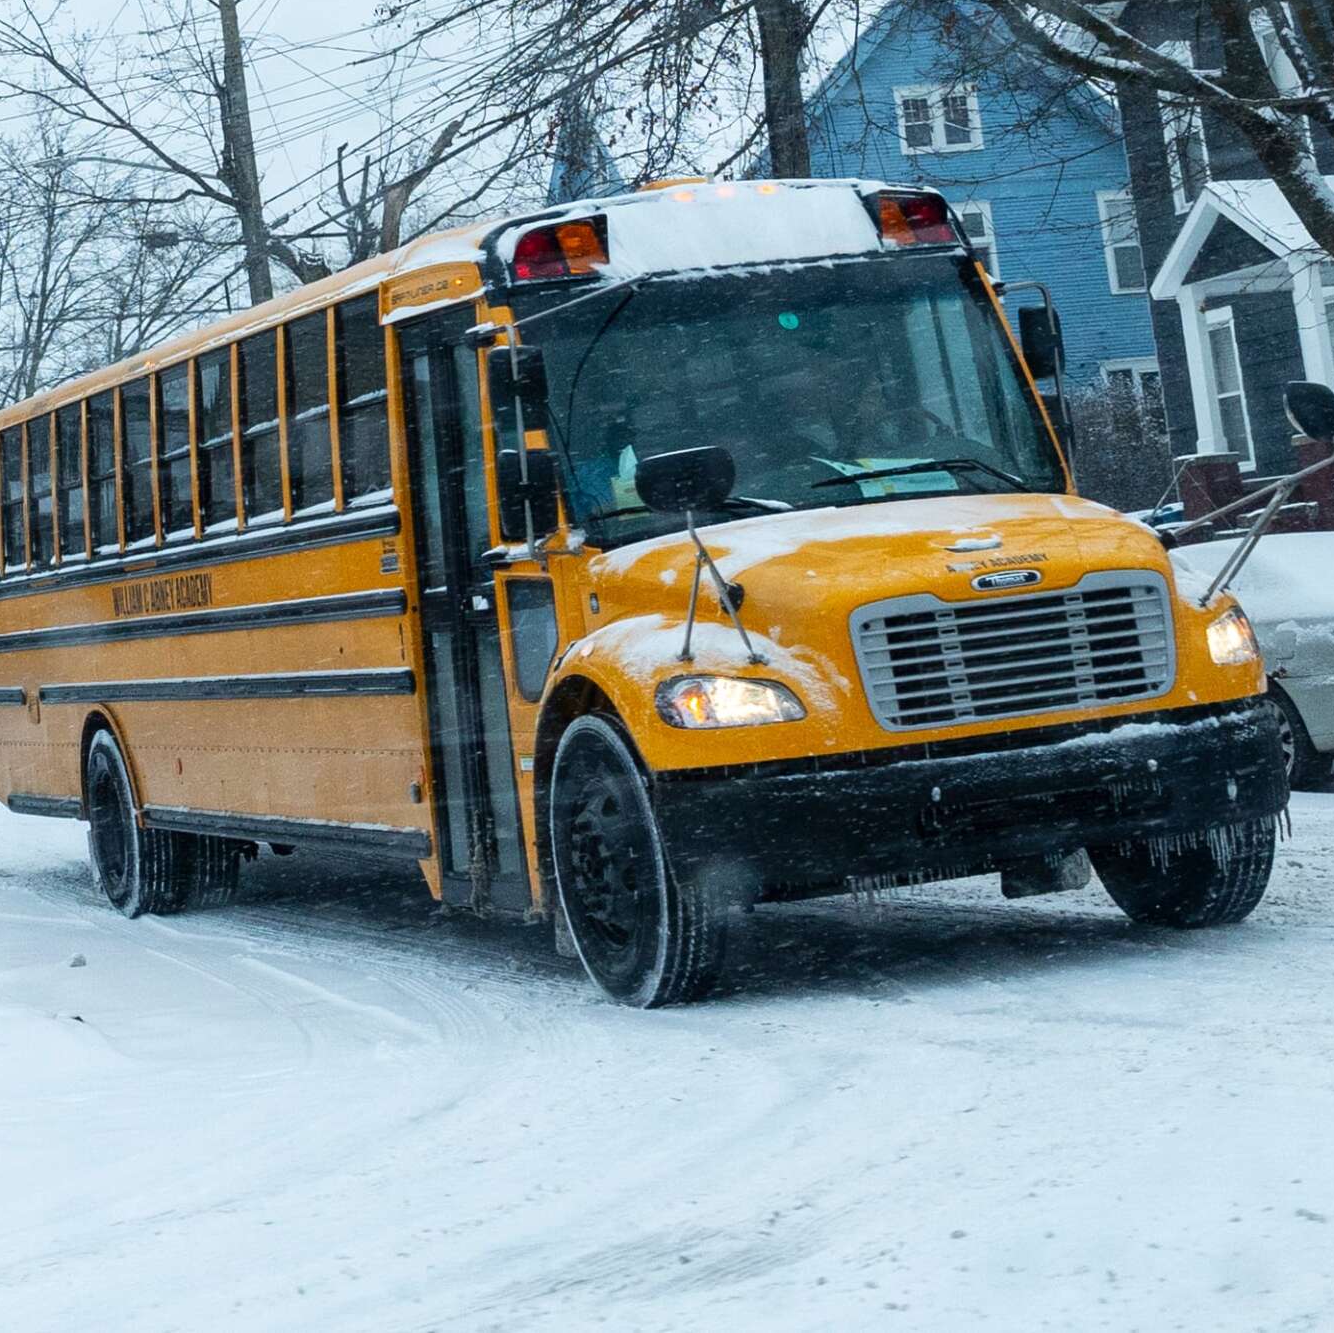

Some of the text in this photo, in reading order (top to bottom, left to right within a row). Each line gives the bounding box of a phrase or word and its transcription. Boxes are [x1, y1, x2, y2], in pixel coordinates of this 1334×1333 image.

[989, 553, 1050, 567] ACADEMY
[986, 571, 1028, 587] Thomas
[112, 583, 144, 617] WILLIAM
[150, 578, 175, 612] ABNEY
[176, 573, 213, 609] ACADEMY
